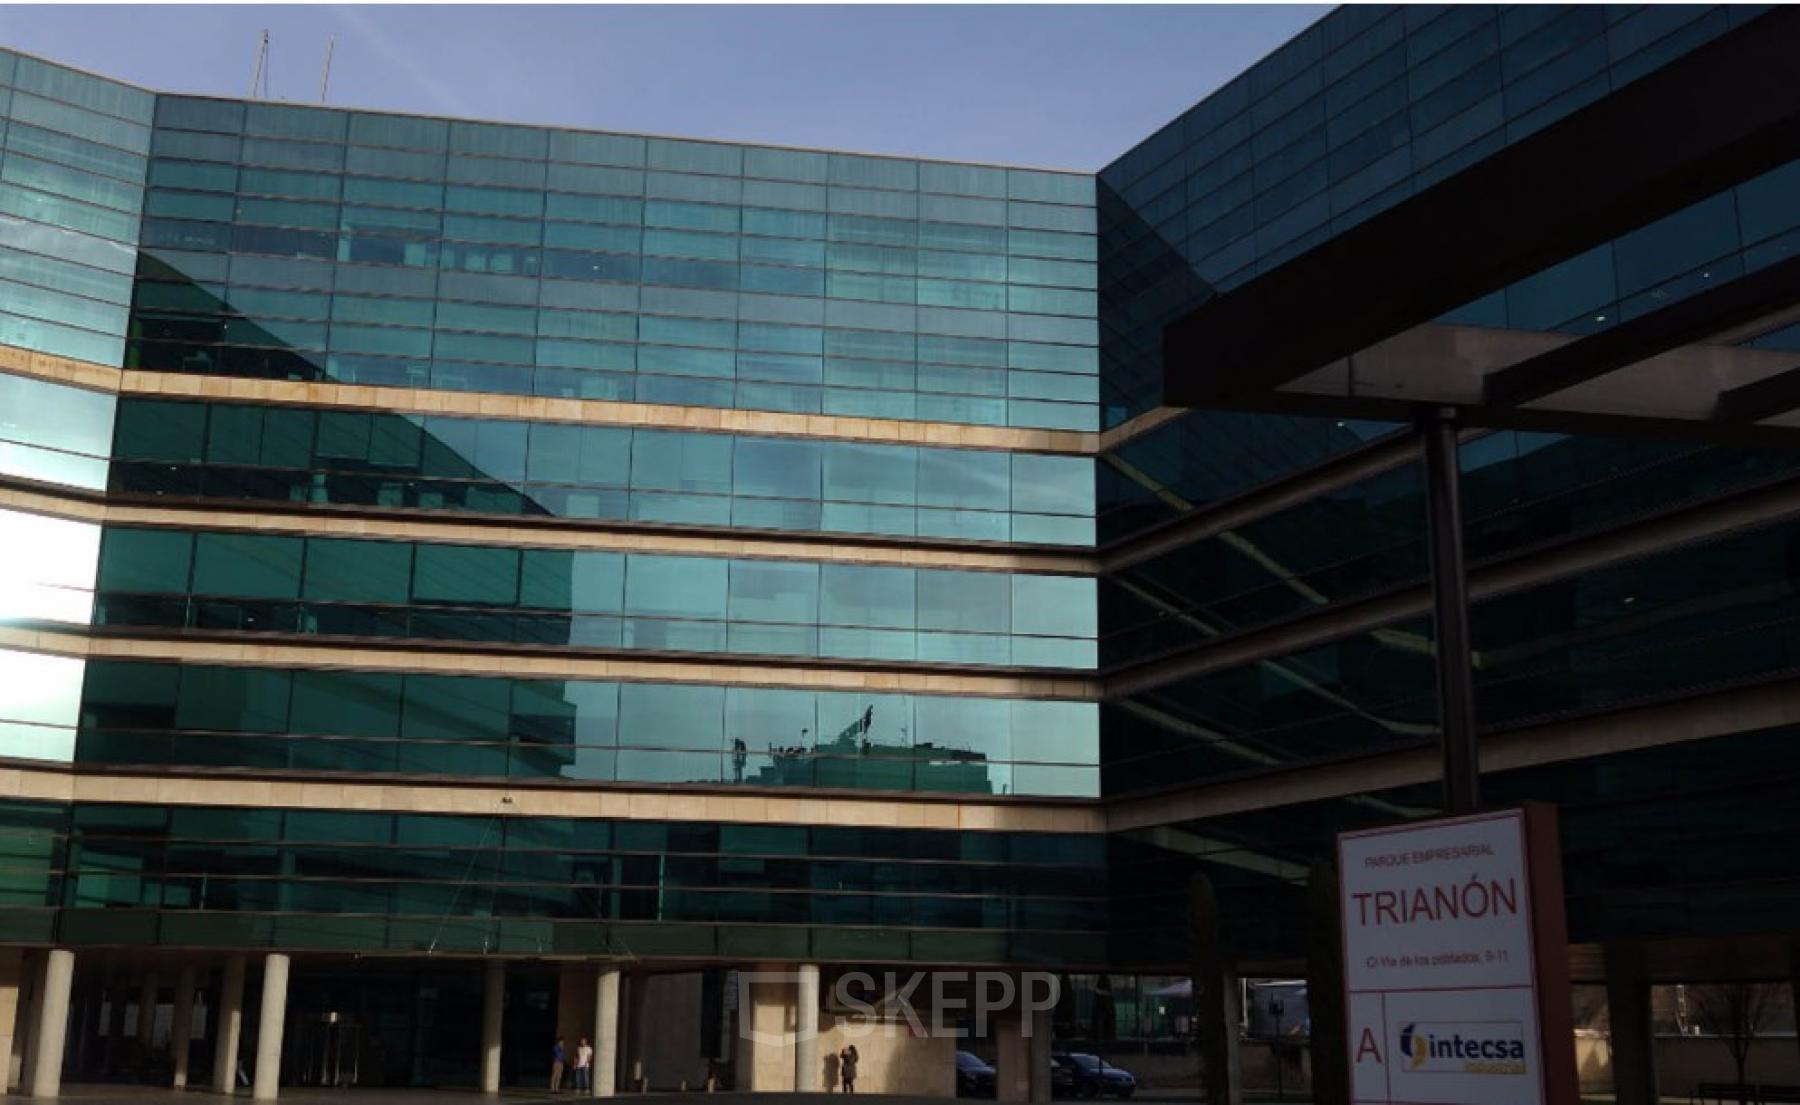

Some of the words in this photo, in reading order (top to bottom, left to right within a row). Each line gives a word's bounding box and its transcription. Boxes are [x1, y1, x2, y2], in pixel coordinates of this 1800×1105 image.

[1365, 854, 1411, 868] PARQUE
[1412, 843, 1495, 864] EMPRESARIAL
[1353, 873, 1517, 926] TRIANÓN
[1356, 1027, 1382, 1063] A
[1429, 1034, 1525, 1059] intecsa
